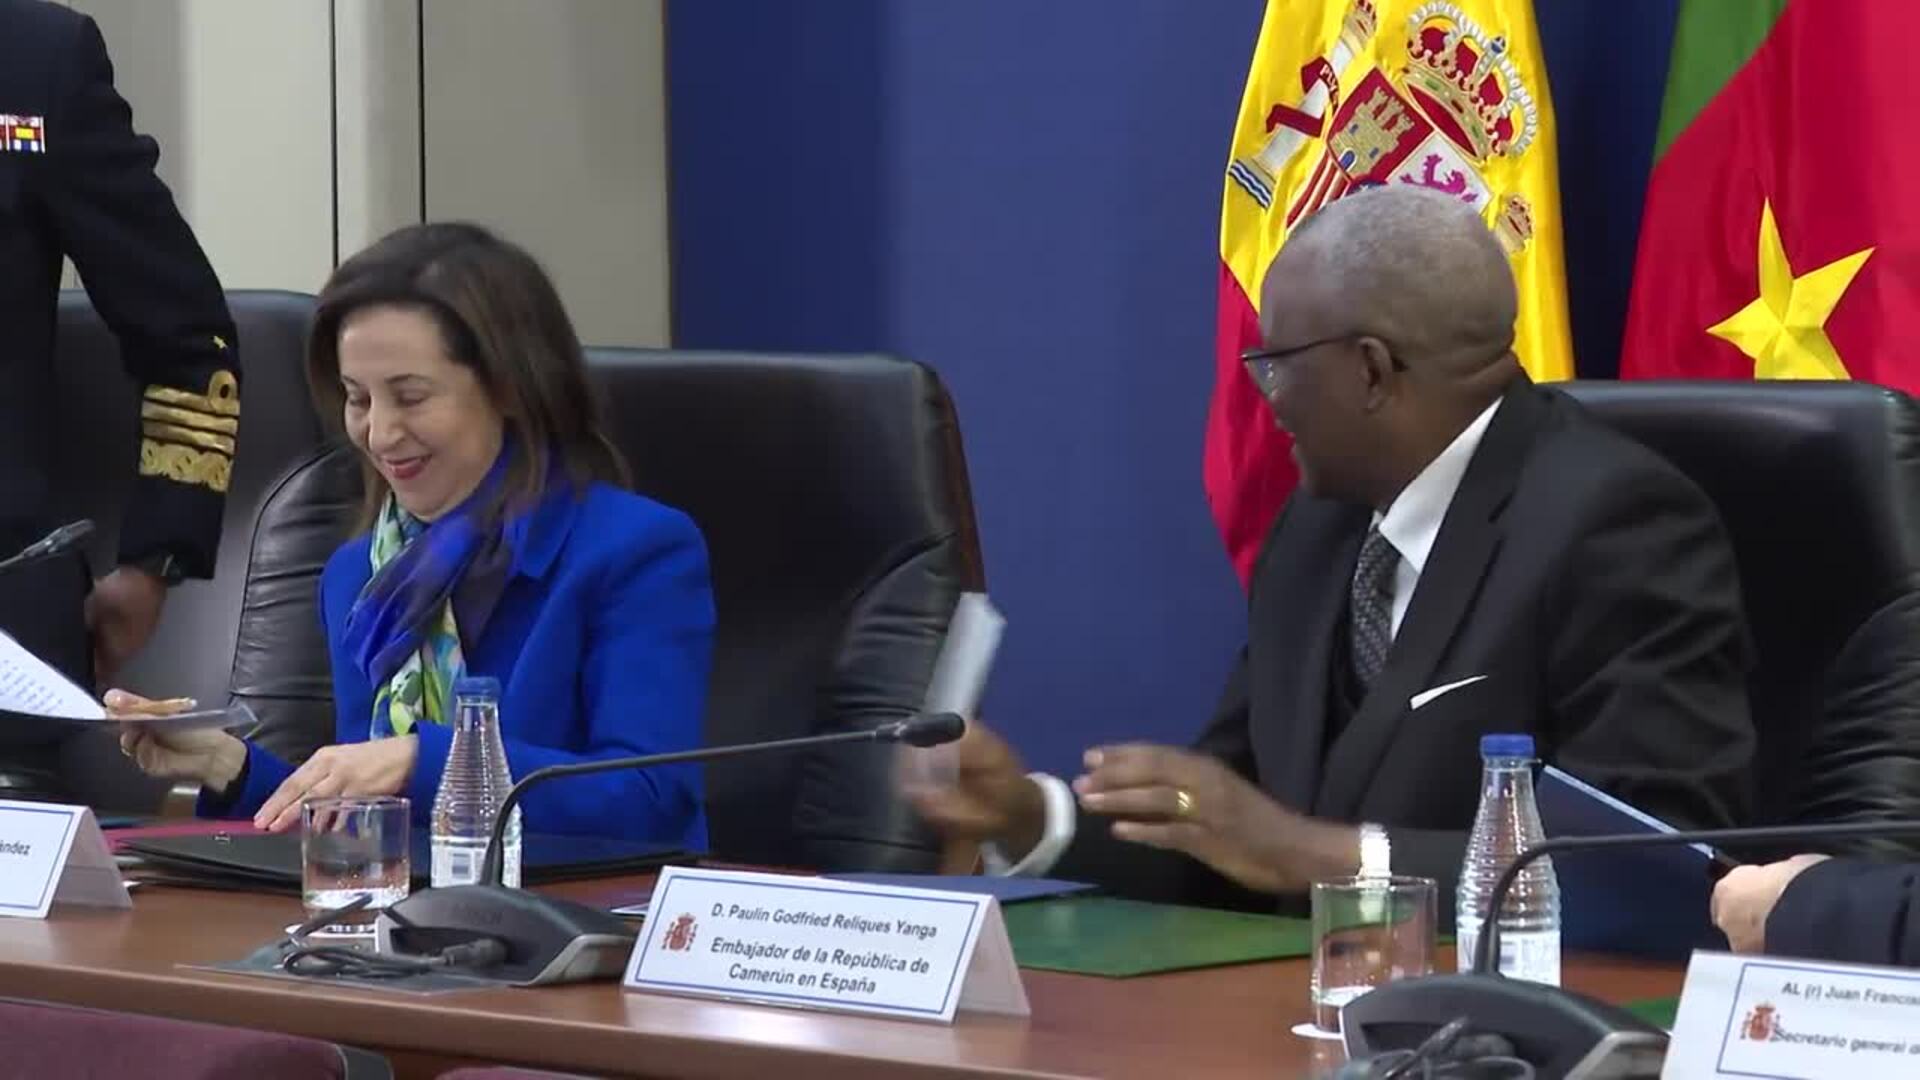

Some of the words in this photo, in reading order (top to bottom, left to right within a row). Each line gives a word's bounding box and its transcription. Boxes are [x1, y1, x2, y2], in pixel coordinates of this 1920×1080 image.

[711, 902, 725, 918] D.
[773, 908, 832, 927] Godfried
[833, 913, 892, 934] Reliques
[896, 918, 938, 941] Yanga
[710, 936, 792, 960] Embajador
[792, 944, 812, 962] de
[814, 946, 829, 963] la
[832, 948, 908, 971] República
[910, 957, 931, 974] de
[728, 962, 796, 984] Camerún
[798, 972, 817, 988] en
[819, 971, 878, 993] España
[1781, 982, 1800, 996] AL
[1825, 985, 1861, 1001] Juan
[1774, 1028, 1847, 1049] Secretario
[1850, 1036, 1907, 1054] general
